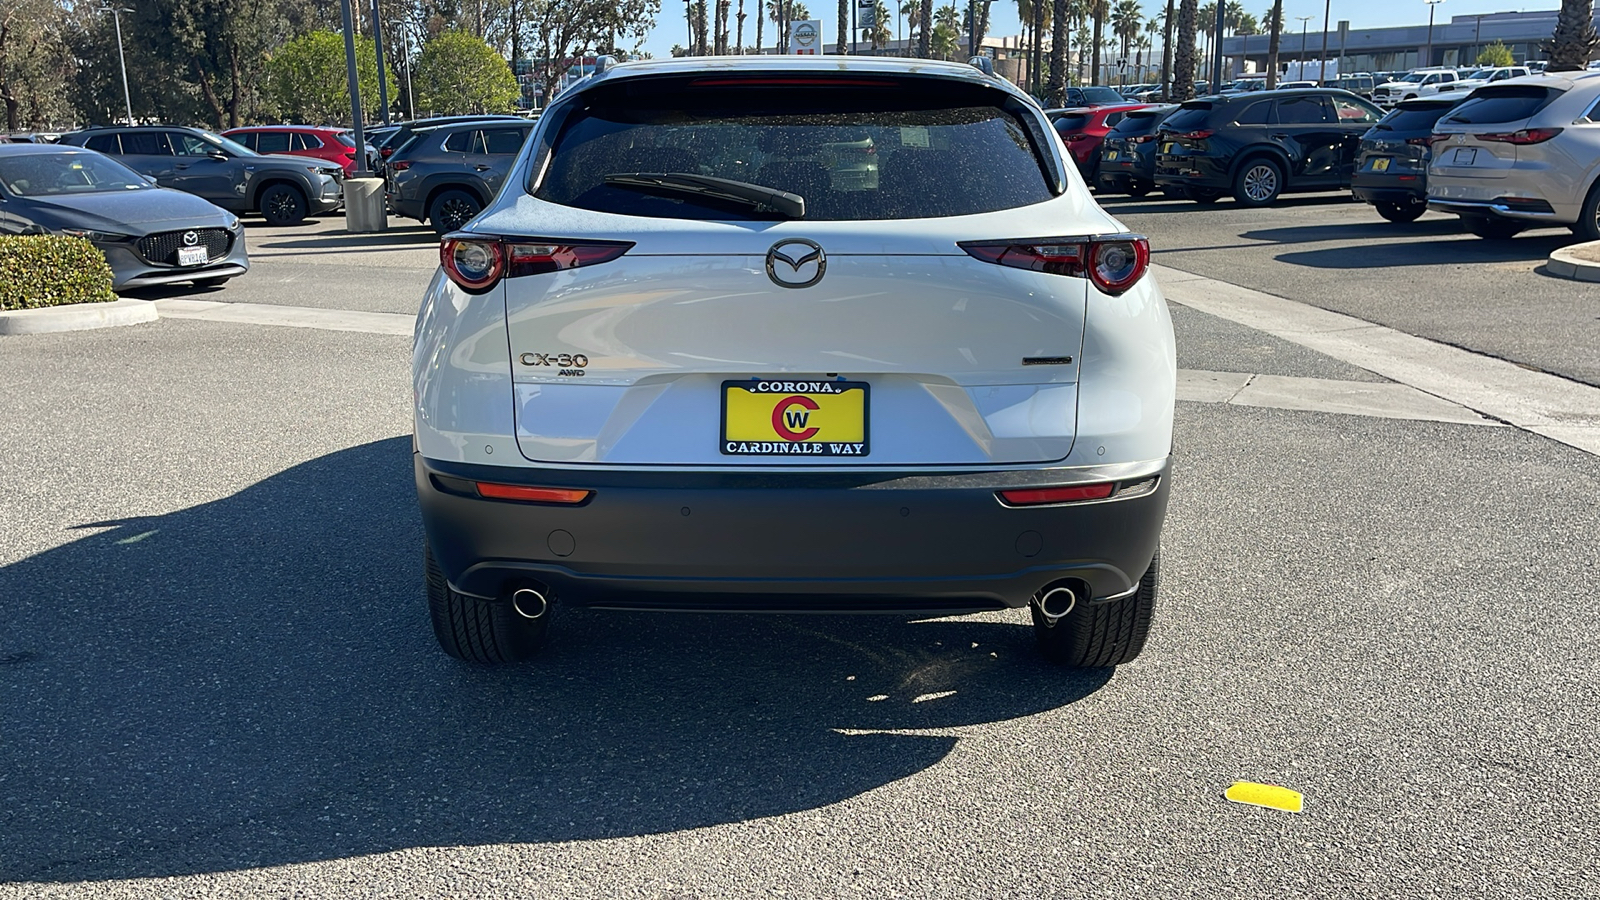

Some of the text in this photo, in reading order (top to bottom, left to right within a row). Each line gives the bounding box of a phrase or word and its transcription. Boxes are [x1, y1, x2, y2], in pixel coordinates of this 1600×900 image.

[519, 352, 588, 368] CX-30
[557, 369, 585, 377] AWD
[758, 382, 833, 393] CORONA
[726, 442, 864, 454] CARDINALE WAY
